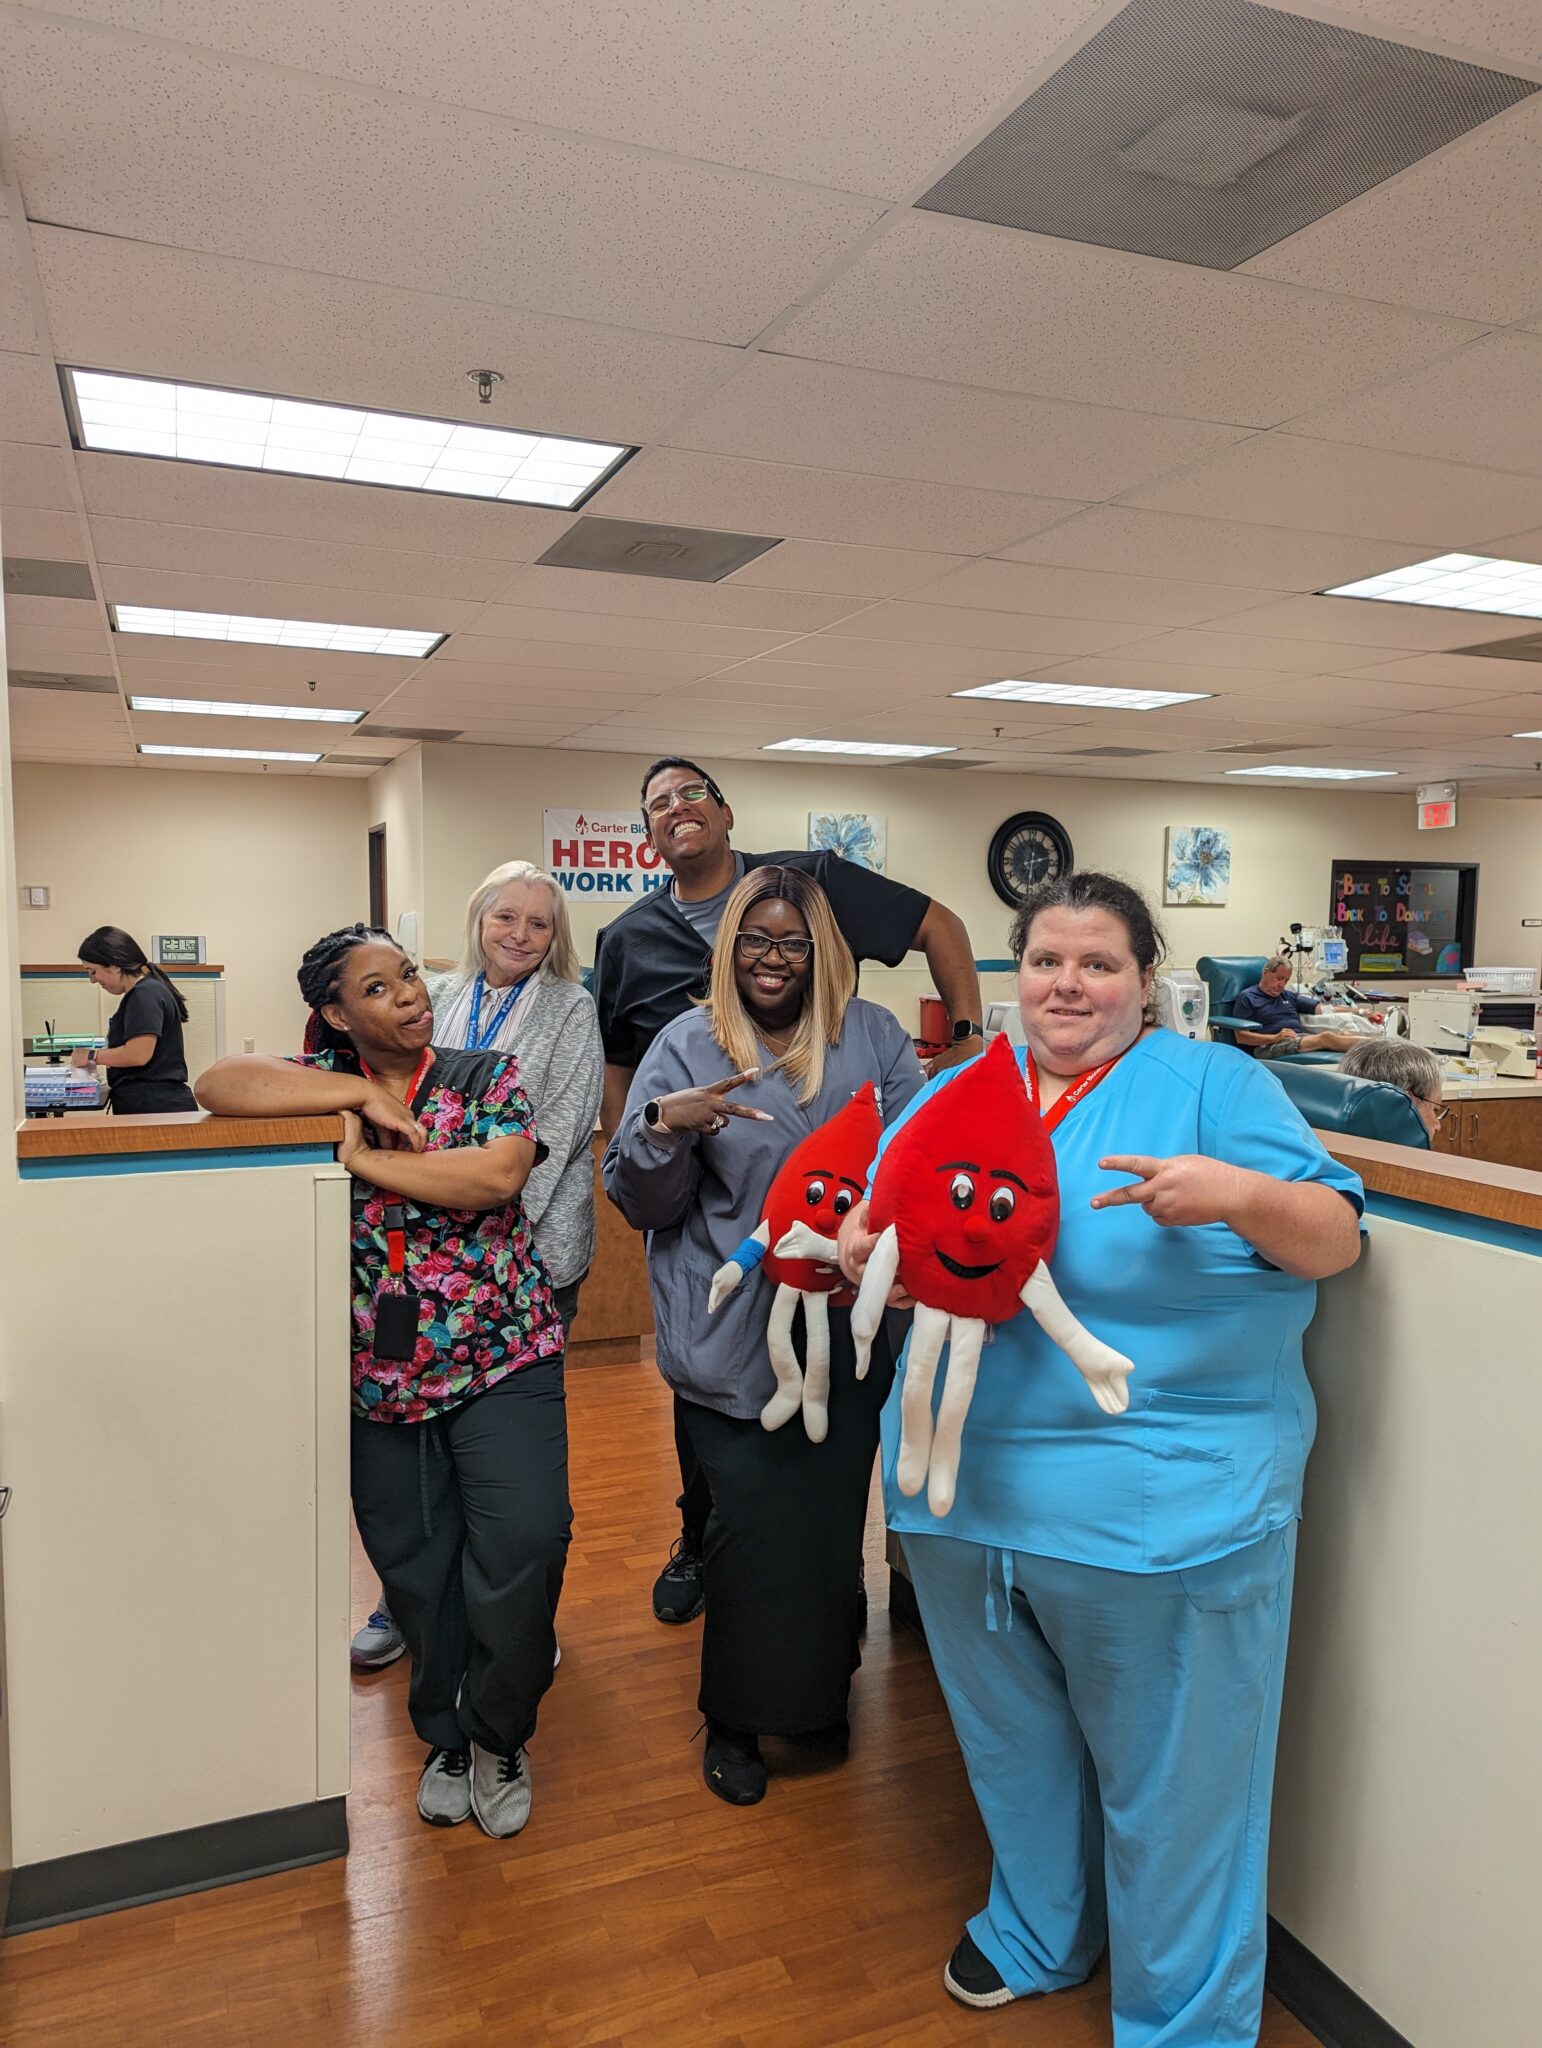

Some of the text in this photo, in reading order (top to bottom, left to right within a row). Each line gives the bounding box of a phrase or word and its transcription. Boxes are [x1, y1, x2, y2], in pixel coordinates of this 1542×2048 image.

[591, 822, 628, 834] Carter
[552, 839, 671, 870] HERO
[551, 872, 633, 892] WORK
